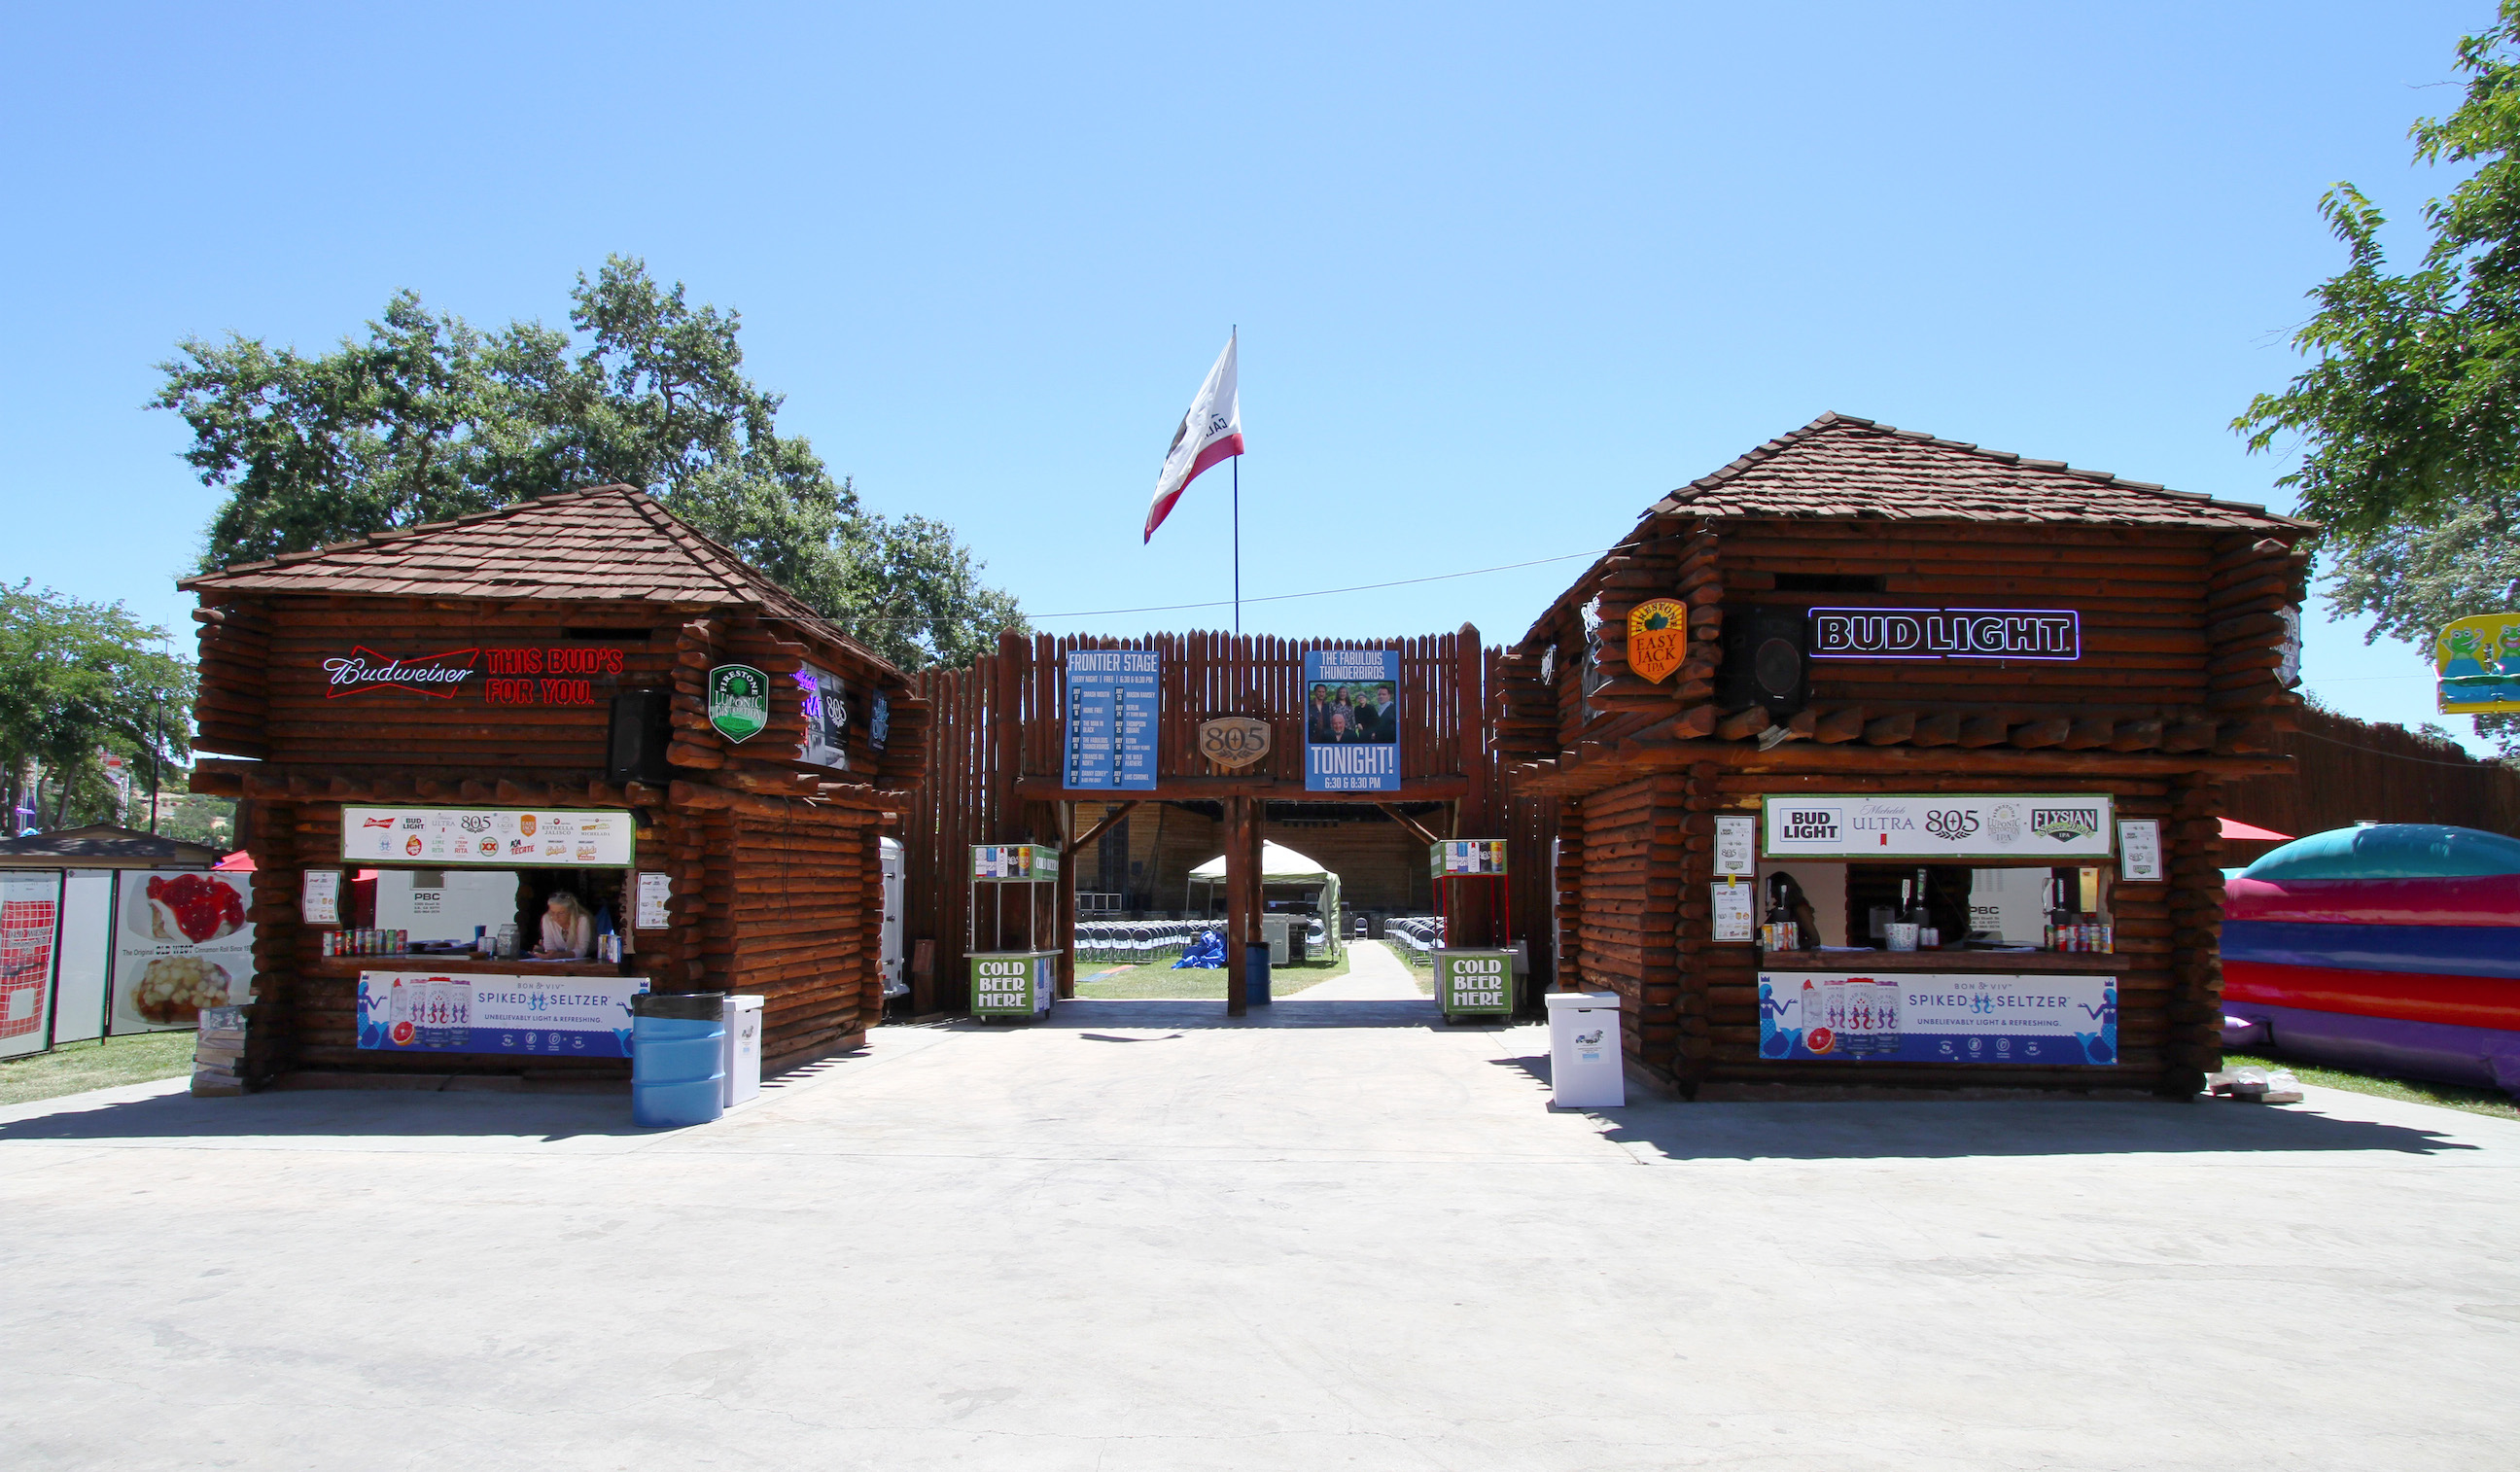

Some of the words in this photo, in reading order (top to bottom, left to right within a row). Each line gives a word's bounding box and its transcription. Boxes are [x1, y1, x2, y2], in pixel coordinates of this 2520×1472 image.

[1636, 603, 1676, 632] FIRESTONE
[1818, 616, 1920, 650] BUD
[1927, 616, 2070, 651] LIGHT
[1636, 634, 1677, 650] EASY
[486, 648, 542, 674] THIS
[1069, 653, 1120, 671] FRONTIER
[1124, 654, 1157, 672] STAGE
[1321, 652, 1337, 665] THE
[1340, 652, 1382, 666] FABULOUS
[1636, 648, 1675, 666] JACK
[323, 657, 473, 684] Budweiser
[1319, 666, 1384, 680] THUNDERBIRDS
[1647, 662, 1664, 673] IPA
[719, 670, 758, 695] FIRESTONE
[486, 679, 533, 704] FOR
[541, 680, 595, 705] YOU.
[716, 690, 762, 709] LUPONIC
[716, 706, 760, 720] DISTORTION
[826, 696, 846, 721] 805
[1206, 727, 1264, 752] 805
[1311, 747, 1393, 775] TONIGHT!
[1325, 778, 1341, 789] 6:30
[1343, 778, 1348, 789] &
[1350, 778, 1367, 789] 8:30
[1369, 778, 1381, 789] PM
[1860, 805, 1906, 815] Michelob
[1993, 804, 2014, 818] FIRESTONE
[461, 816, 491, 828] 805
[1792, 813, 1830, 824] BUD
[1853, 818, 1914, 830] ULTRA
[1925, 810, 1979, 832] 805
[1987, 818, 2019, 826] LUPONIC
[2035, 810, 2095, 830] ELYSIAN
[1784, 826, 1838, 838] LIGHT
[2039, 824, 2064, 837] Space
[2067, 822, 2090, 836] Dust
[510, 845, 535, 856] TECATE
[1036, 857, 1046, 869] COLD
[156, 946, 170, 955] OLD
[173, 945, 193, 954] WEST
[979, 962, 1025, 976] COLD
[1452, 960, 1501, 974] COLD
[980, 978, 1025, 992] BEER
[1454, 976, 1501, 990] BEER
[1978, 981, 1987, 991] &
[478, 993, 526, 1003] SPIKED
[550, 995, 608, 1006] SELTZER
[978, 994, 1026, 1006] HERE
[1453, 992, 1503, 1005] HERE
[1909, 995, 1967, 1007] SPIKED
[1997, 996, 2067, 1007] SELTZER
[2009, 1019, 2061, 1028] REFRESHING.
